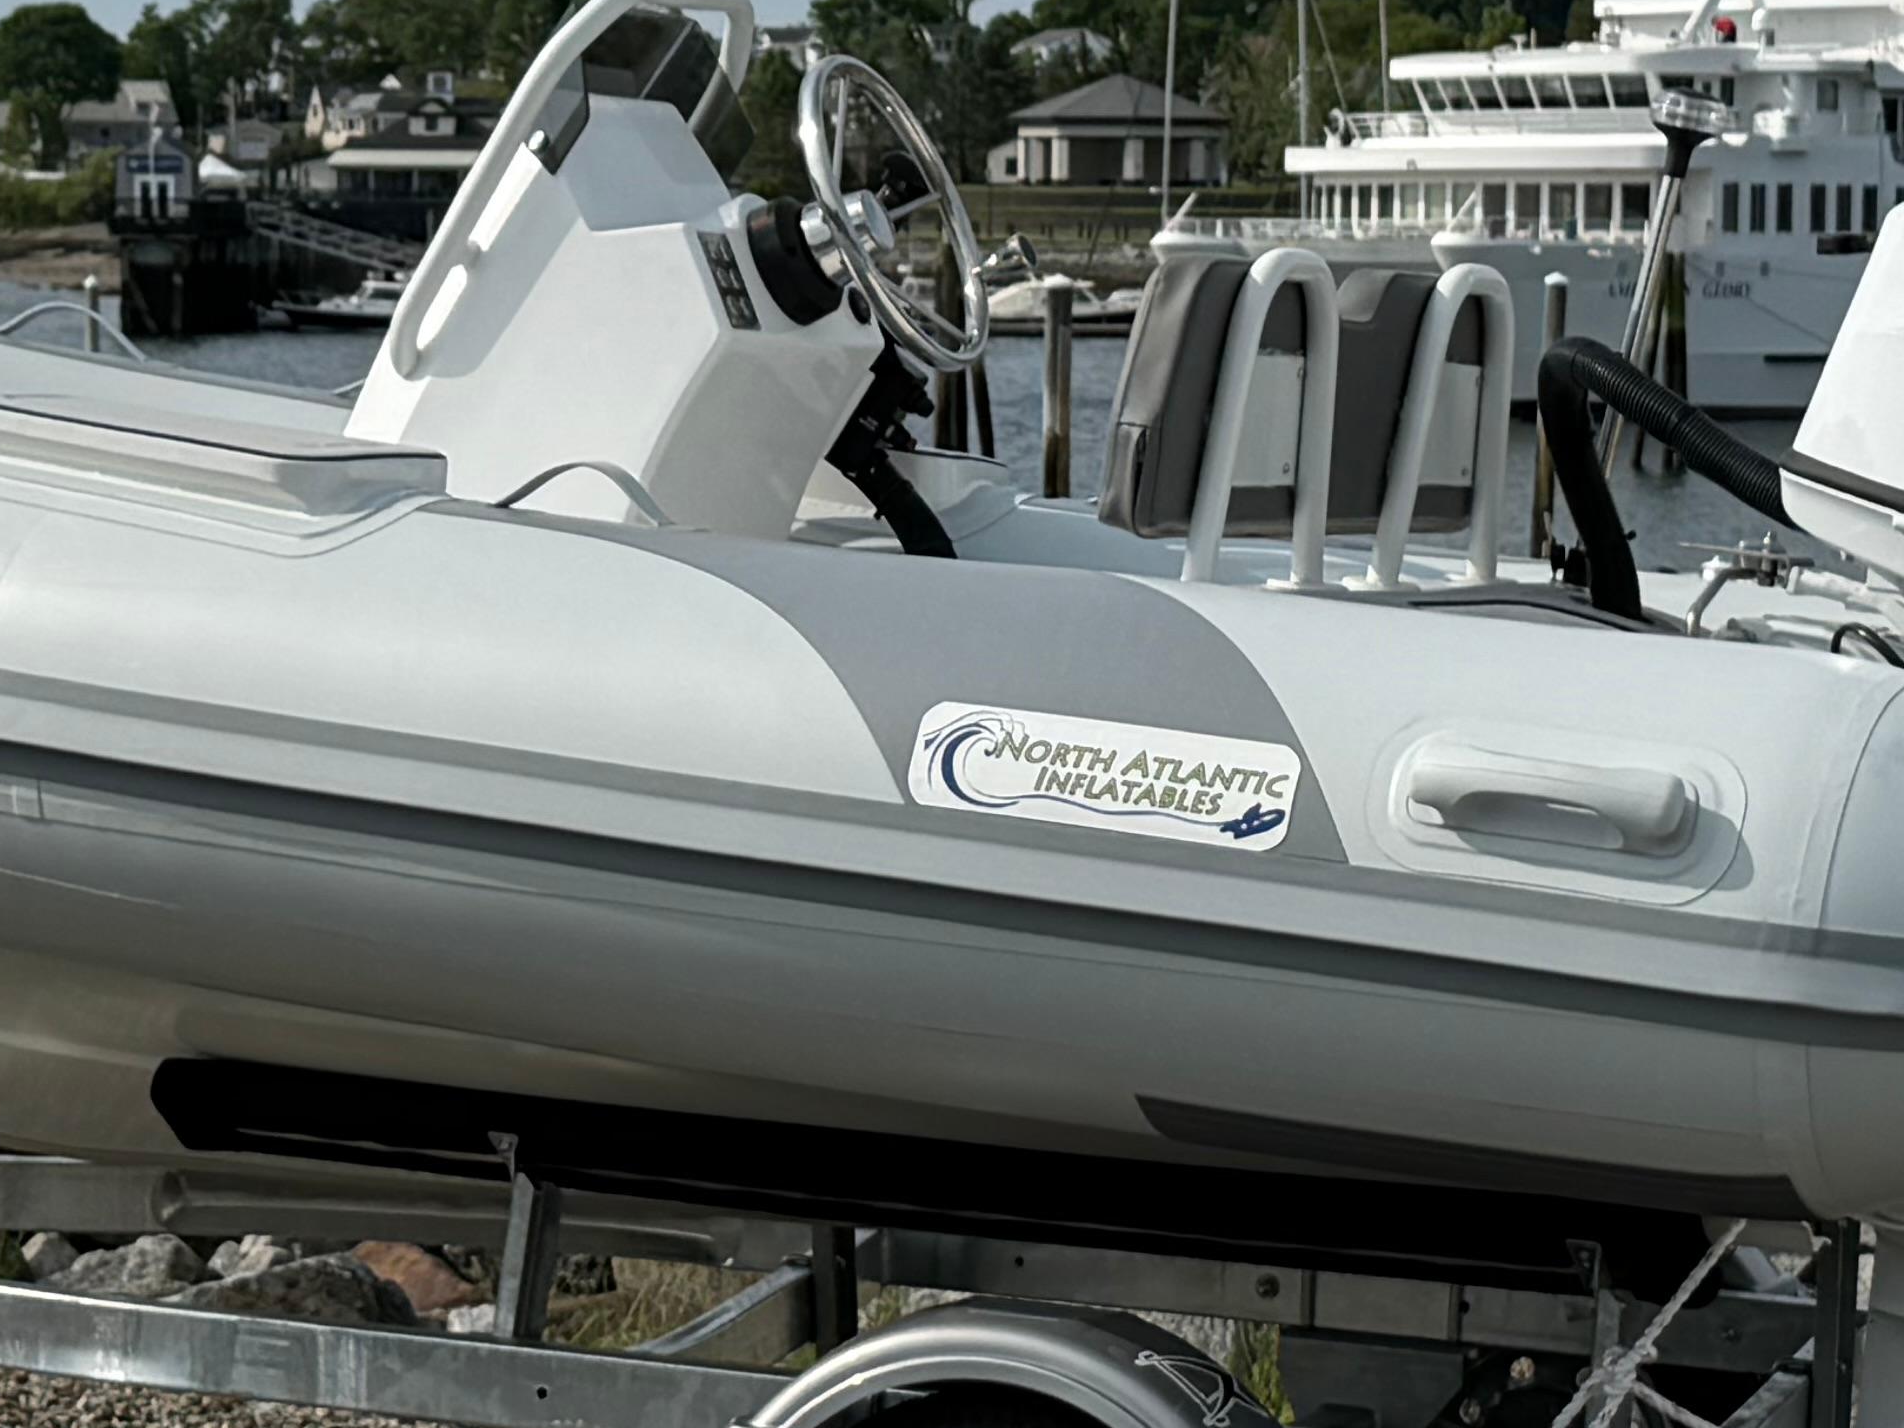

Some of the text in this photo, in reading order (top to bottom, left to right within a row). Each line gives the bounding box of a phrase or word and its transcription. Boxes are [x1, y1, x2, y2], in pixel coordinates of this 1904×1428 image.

[996, 731, 1290, 799] NORTH ATLANTIC
[1033, 766, 1224, 816] INFLATABLES
